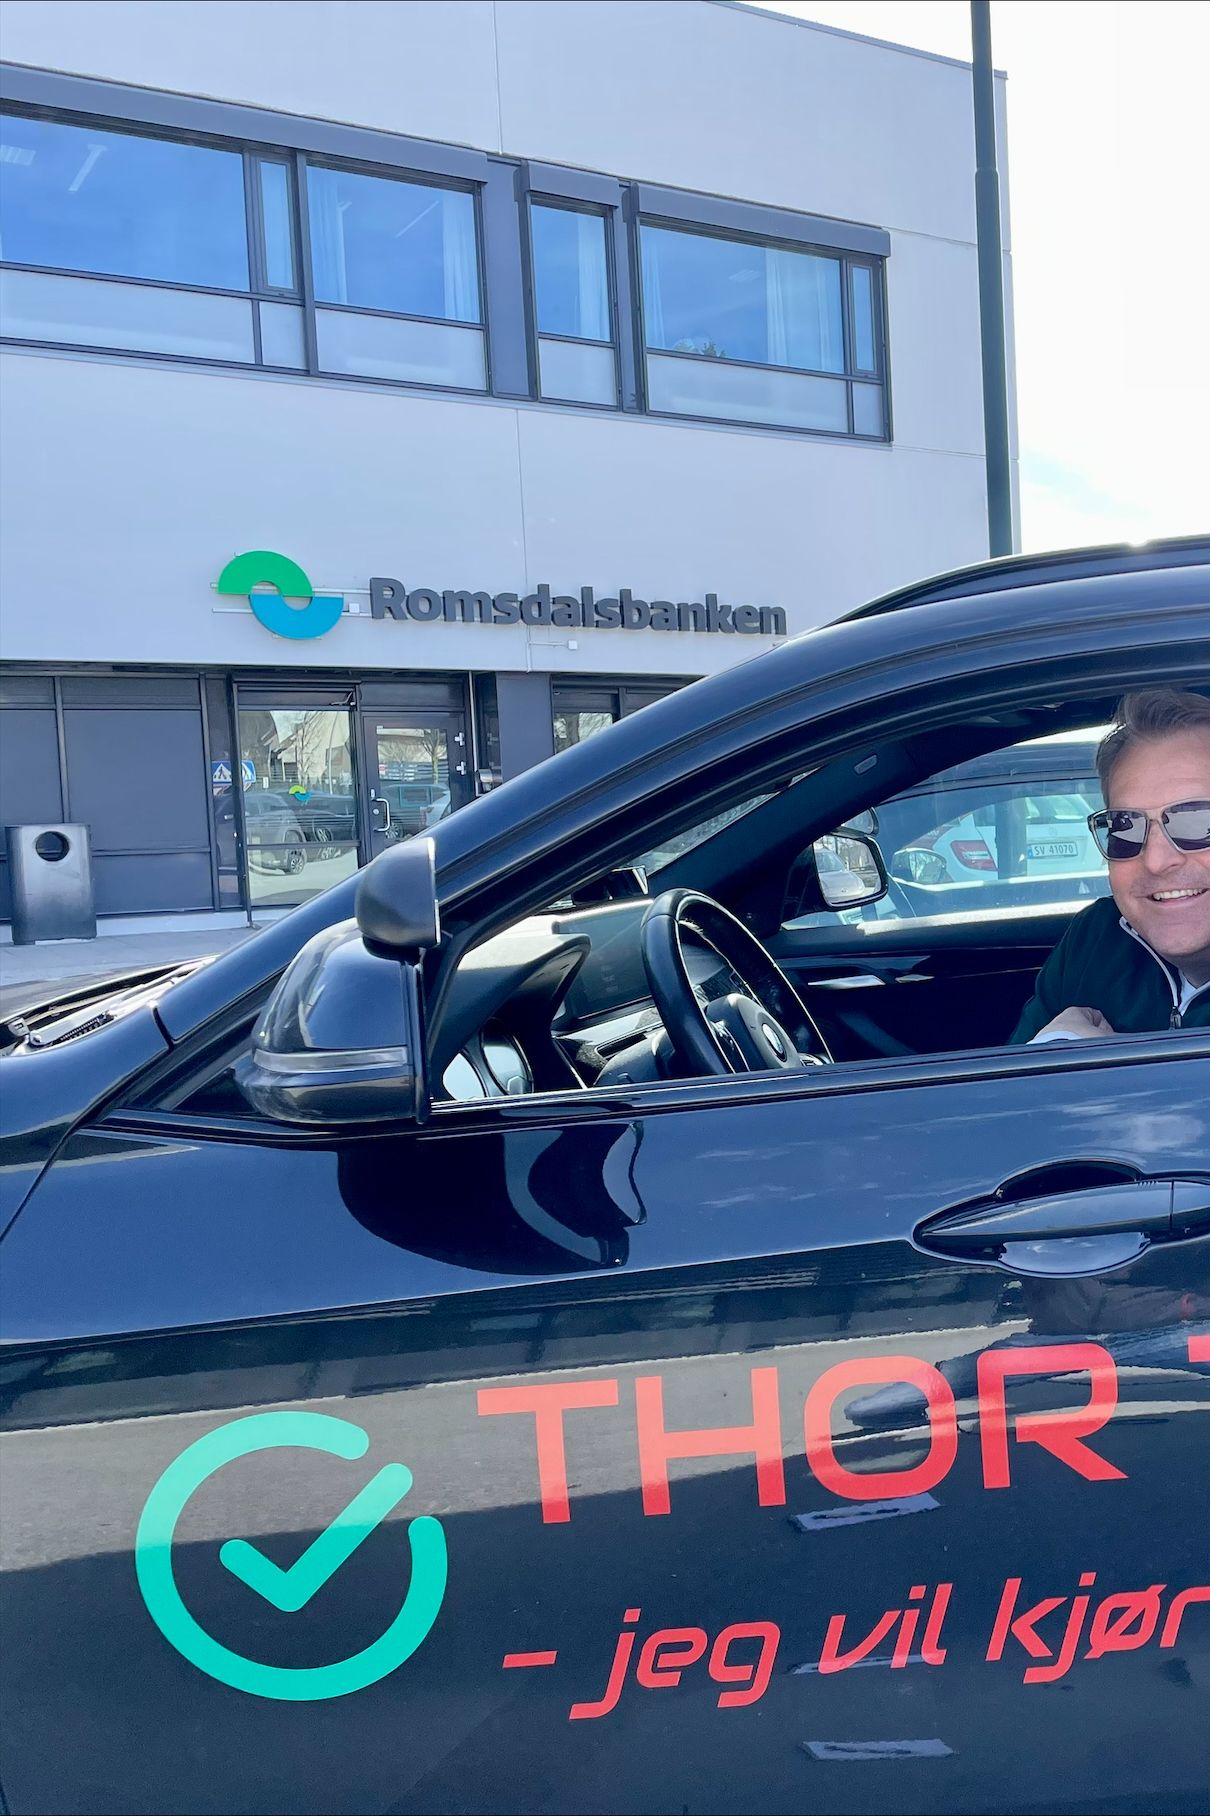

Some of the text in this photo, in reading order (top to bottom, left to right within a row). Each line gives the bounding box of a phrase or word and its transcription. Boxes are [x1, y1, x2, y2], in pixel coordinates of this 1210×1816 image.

[370, 577, 788, 635] Romsdalsbanken
[1033, 846, 1045, 856] SV
[478, 1344, 1126, 1523] THOR
[570, 1609, 780, 1720] jeg
[819, 1584, 953, 1674] vil
